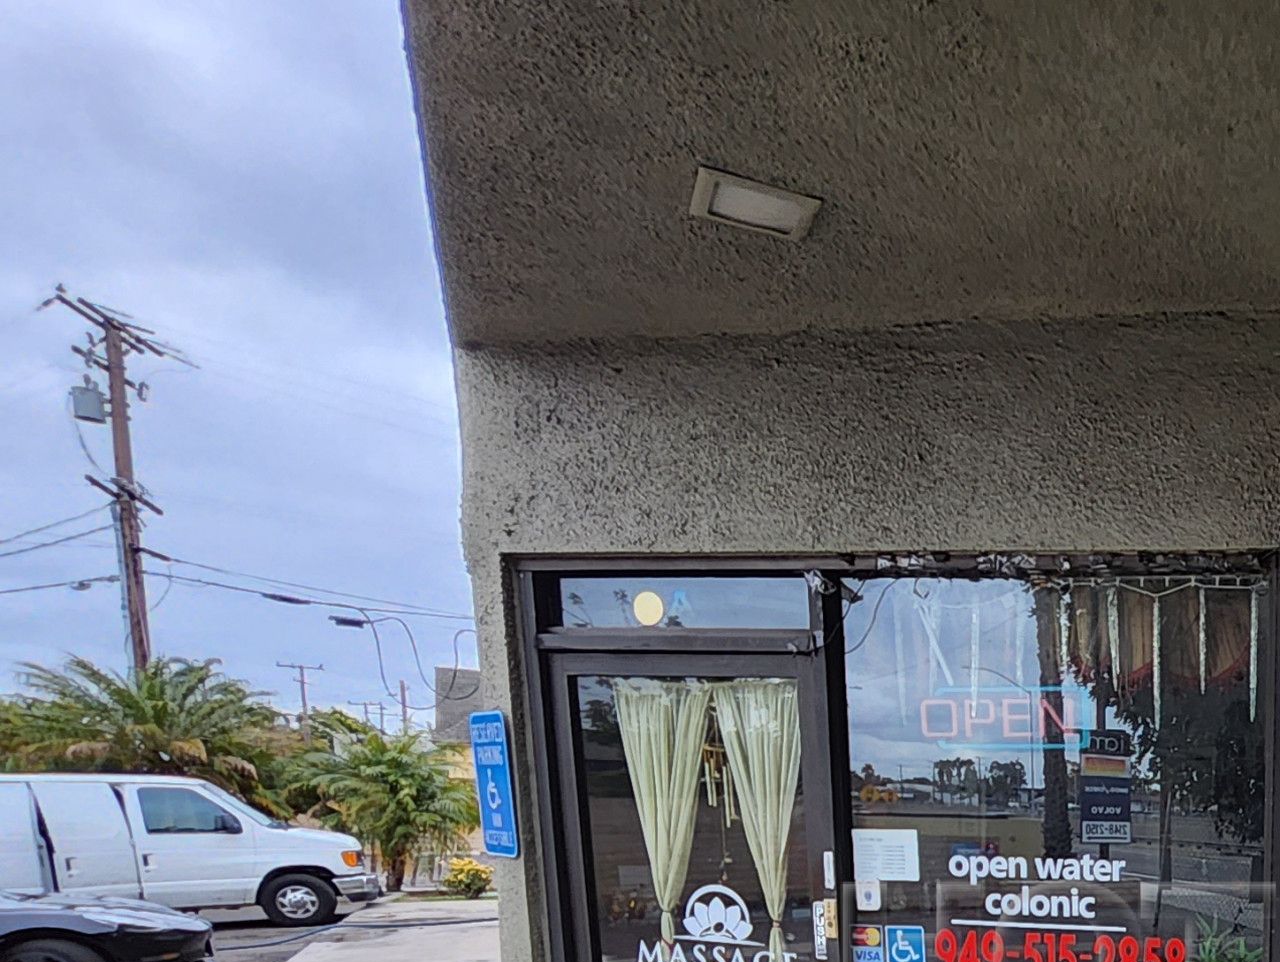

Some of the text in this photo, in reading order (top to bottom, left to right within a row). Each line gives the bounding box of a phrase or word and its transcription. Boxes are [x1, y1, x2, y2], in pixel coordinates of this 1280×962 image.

[920, 697, 1081, 740] OPEN
[949, 854, 1126, 885] open water
[985, 885, 1096, 918] colonic
[815, 906, 827, 946] PUSH
[855, 950, 881, 961] VISA
